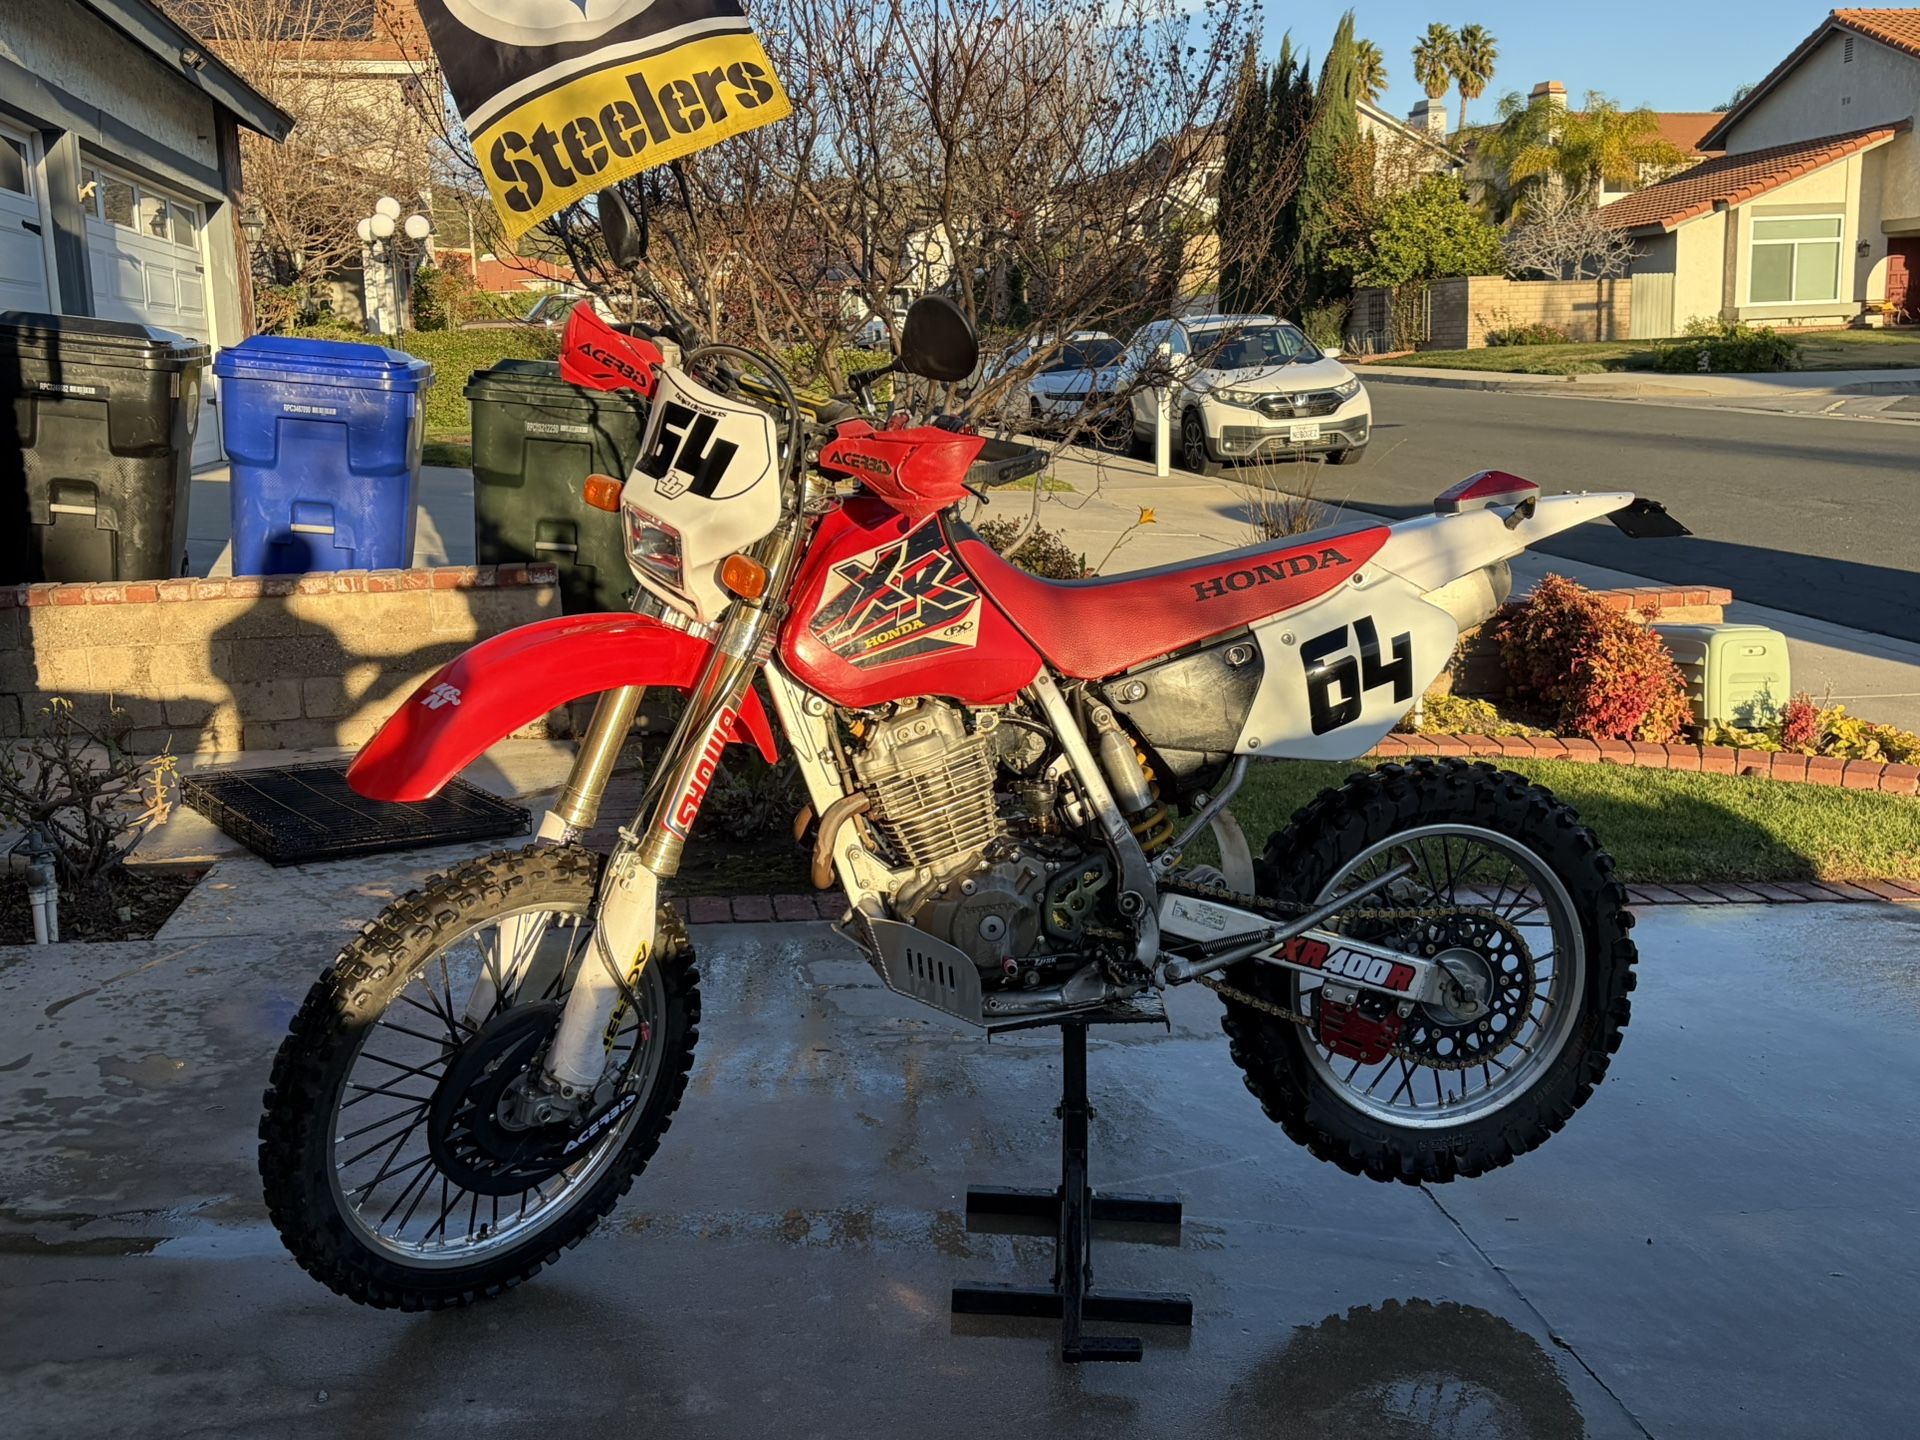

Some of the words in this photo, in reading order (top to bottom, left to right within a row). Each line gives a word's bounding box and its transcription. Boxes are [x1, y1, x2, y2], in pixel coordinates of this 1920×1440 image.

[490, 61, 774, 212] Steelers
[577, 342, 649, 389] ACERBIS
[635, 400, 740, 499] 64
[828, 450, 893, 476] ACERBIS
[1190, 548, 1353, 602] HONDA
[864, 619, 926, 649] HONDA
[1299, 614, 1414, 736] 64
[1270, 936, 1417, 992] XR400R
[562, 1093, 637, 1156] ACERBIS
